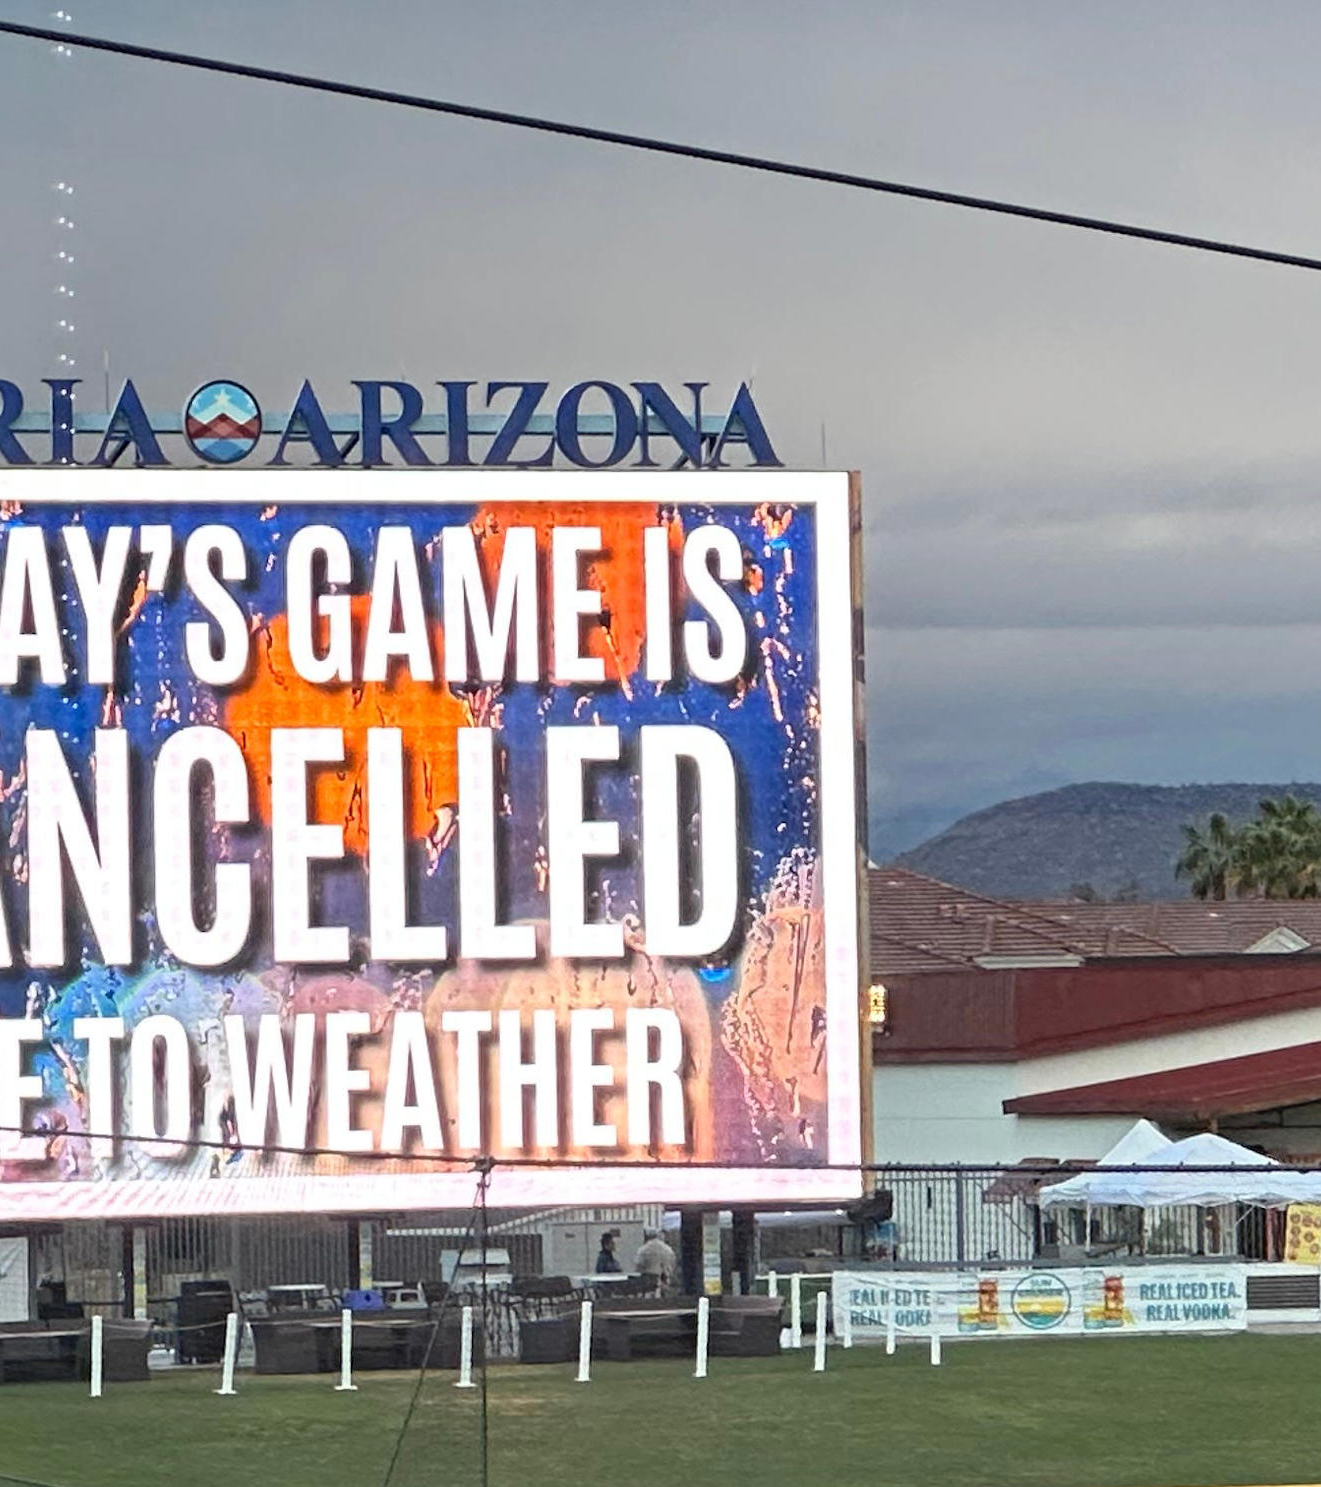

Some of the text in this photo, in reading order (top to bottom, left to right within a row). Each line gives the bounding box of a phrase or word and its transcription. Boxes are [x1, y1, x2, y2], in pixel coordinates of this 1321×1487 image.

[267, 380, 783, 468] ARIZONA
[287, 524, 608, 686] GAME
[645, 524, 747, 682] IS
[70, 1016, 204, 1160] TO
[222, 1008, 687, 1158] WEATHER
[1140, 1283, 1173, 1301] REAL
[1176, 1282, 1208, 1300] ICED
[1146, 1304, 1180, 1321] REAL
